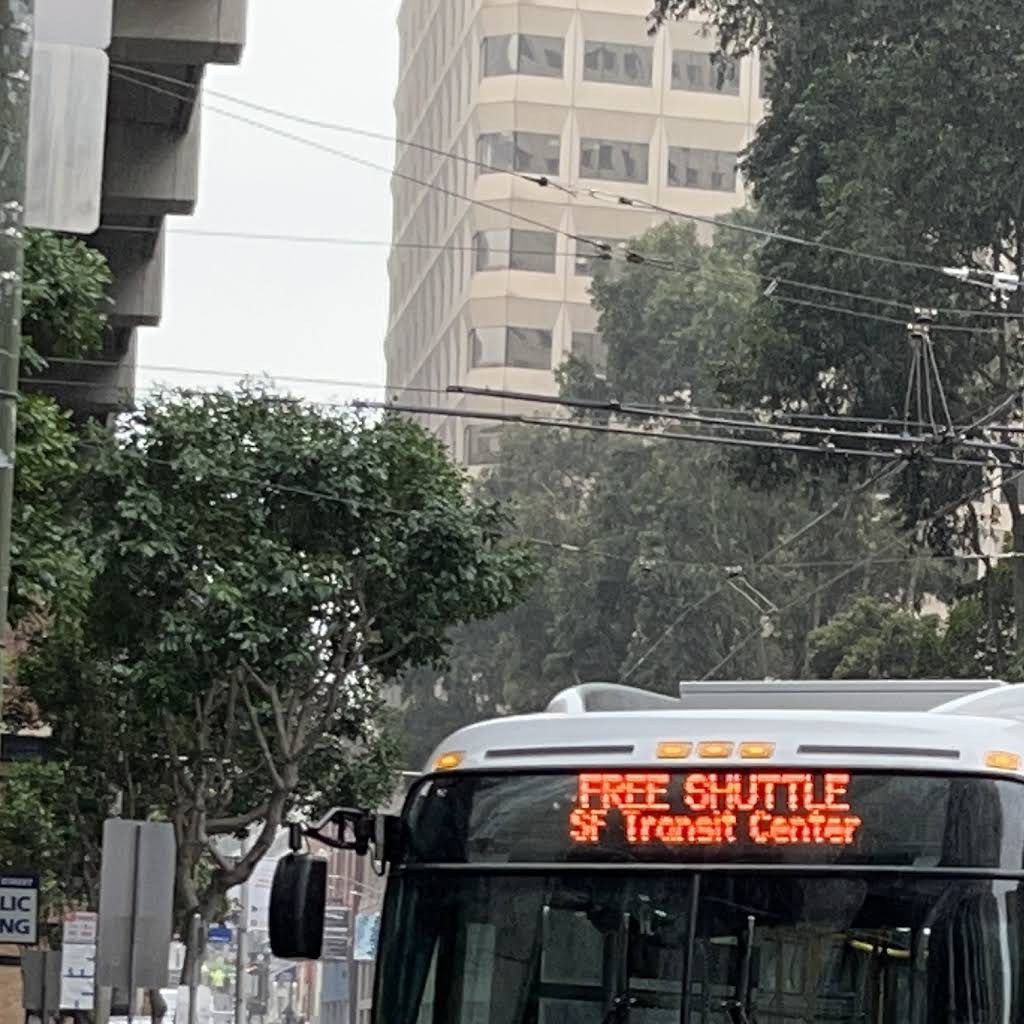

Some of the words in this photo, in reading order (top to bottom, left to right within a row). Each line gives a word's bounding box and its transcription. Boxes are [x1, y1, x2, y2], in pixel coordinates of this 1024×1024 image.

[578, 773, 670, 810] FREE
[684, 773, 850, 811] SHUTTLE
[569, 809, 607, 842] SF
[621, 809, 737, 843] Transit
[749, 809, 861, 843] Center
